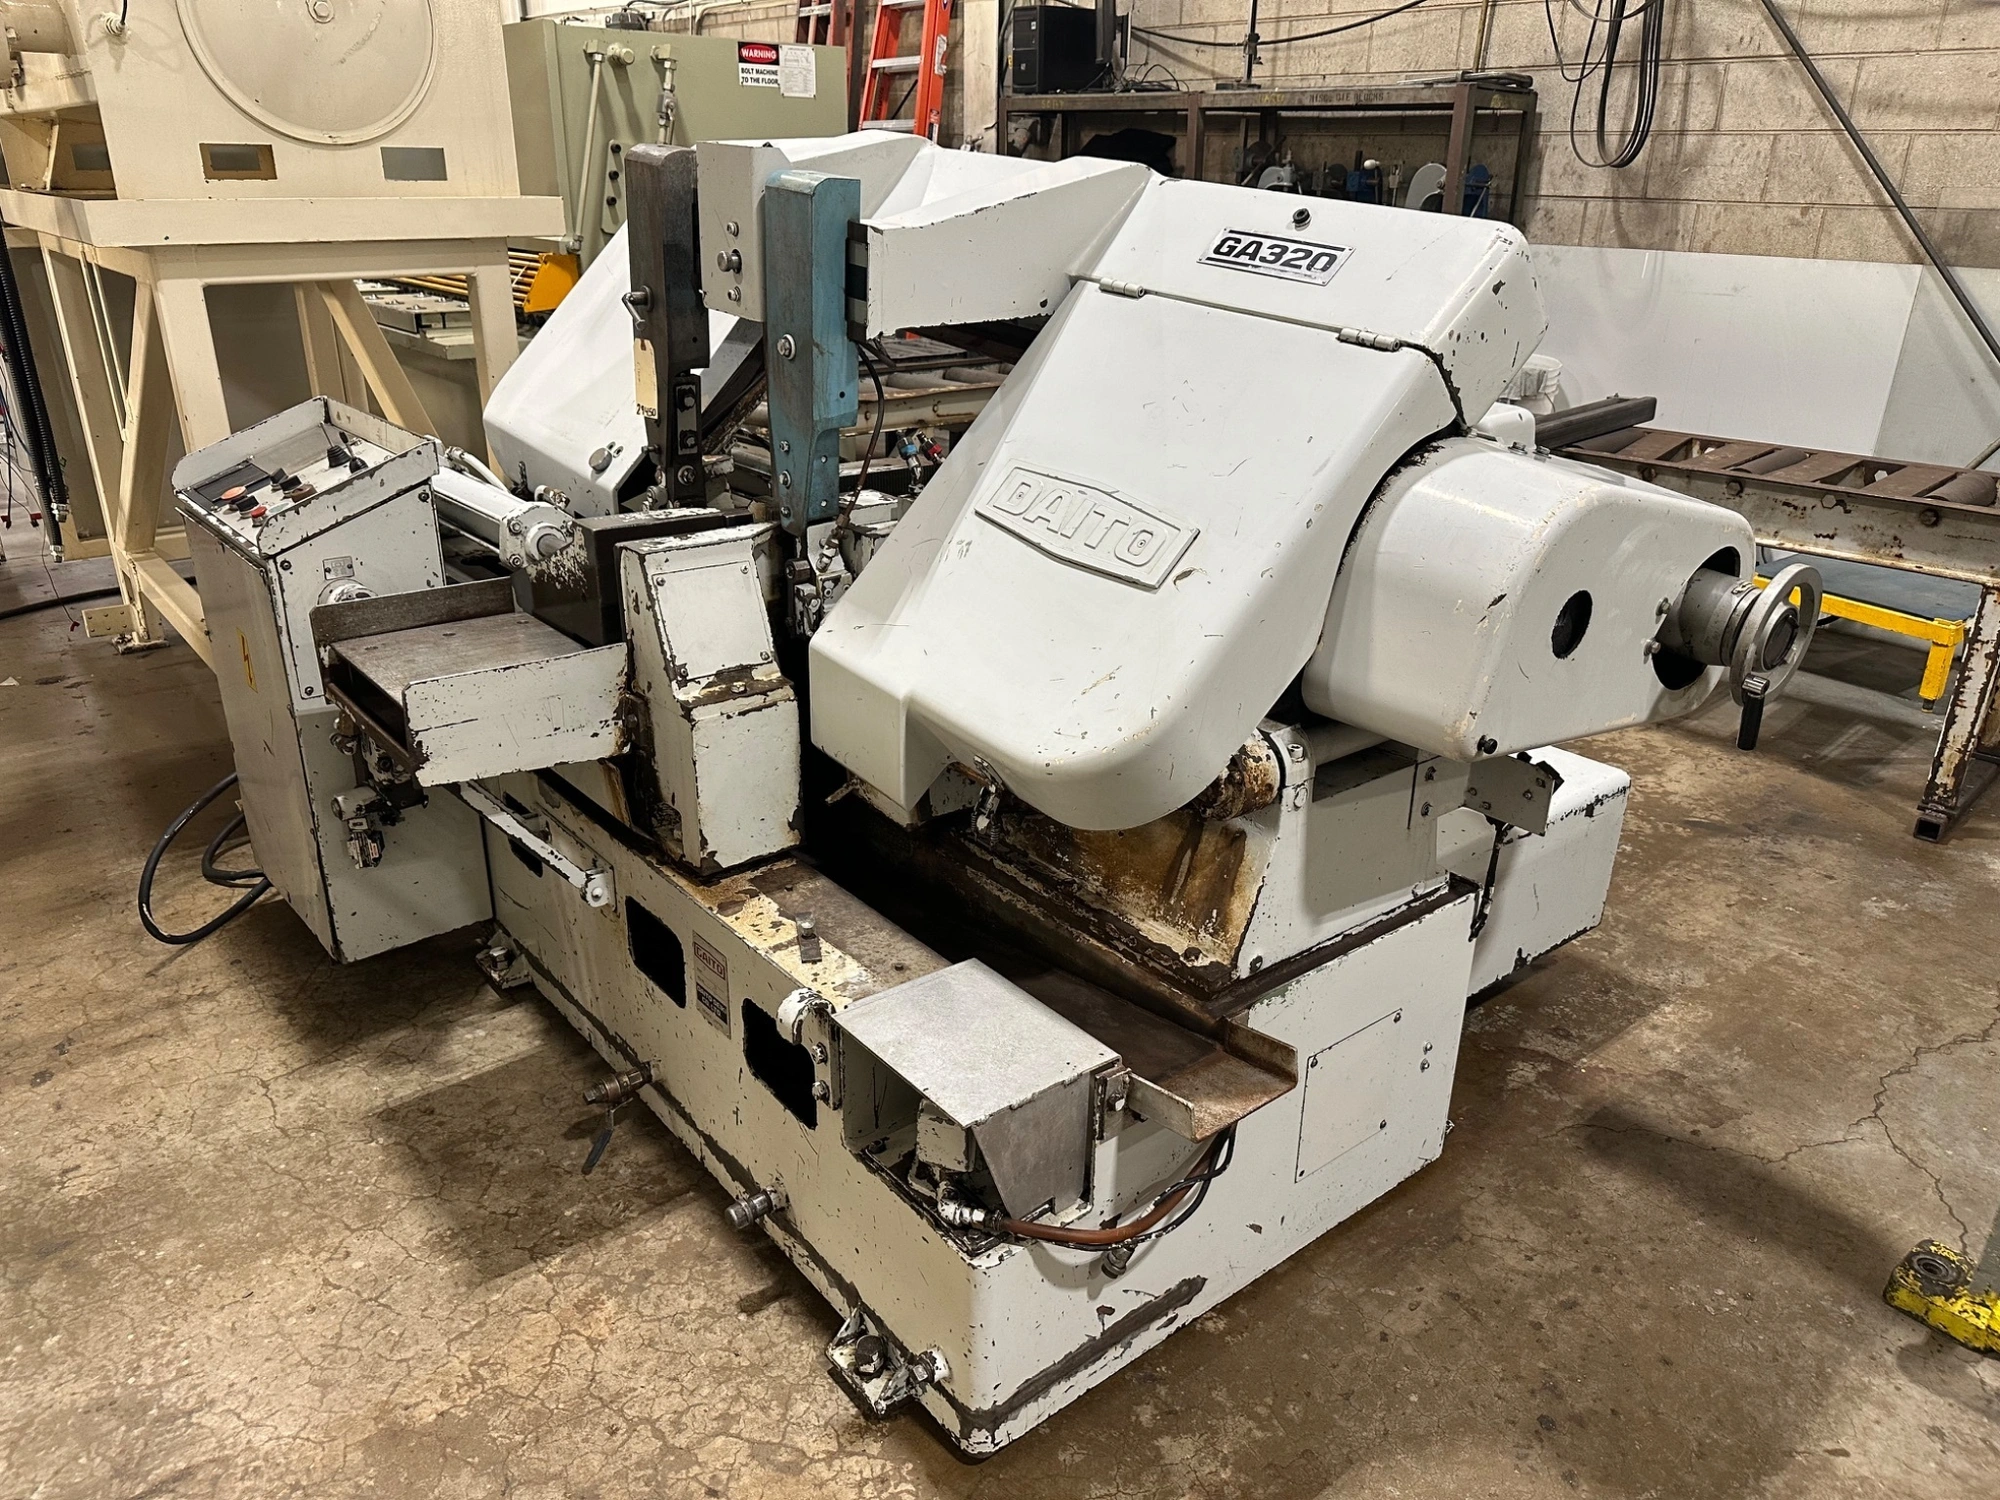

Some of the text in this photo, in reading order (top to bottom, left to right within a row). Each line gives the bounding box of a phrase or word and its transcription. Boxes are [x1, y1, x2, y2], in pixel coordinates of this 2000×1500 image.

[741, 48, 777, 60] WARNING
[741, 67, 754, 75] BOLT
[1213, 236, 1338, 272] GA320
[991, 472, 1168, 567] DAITO
